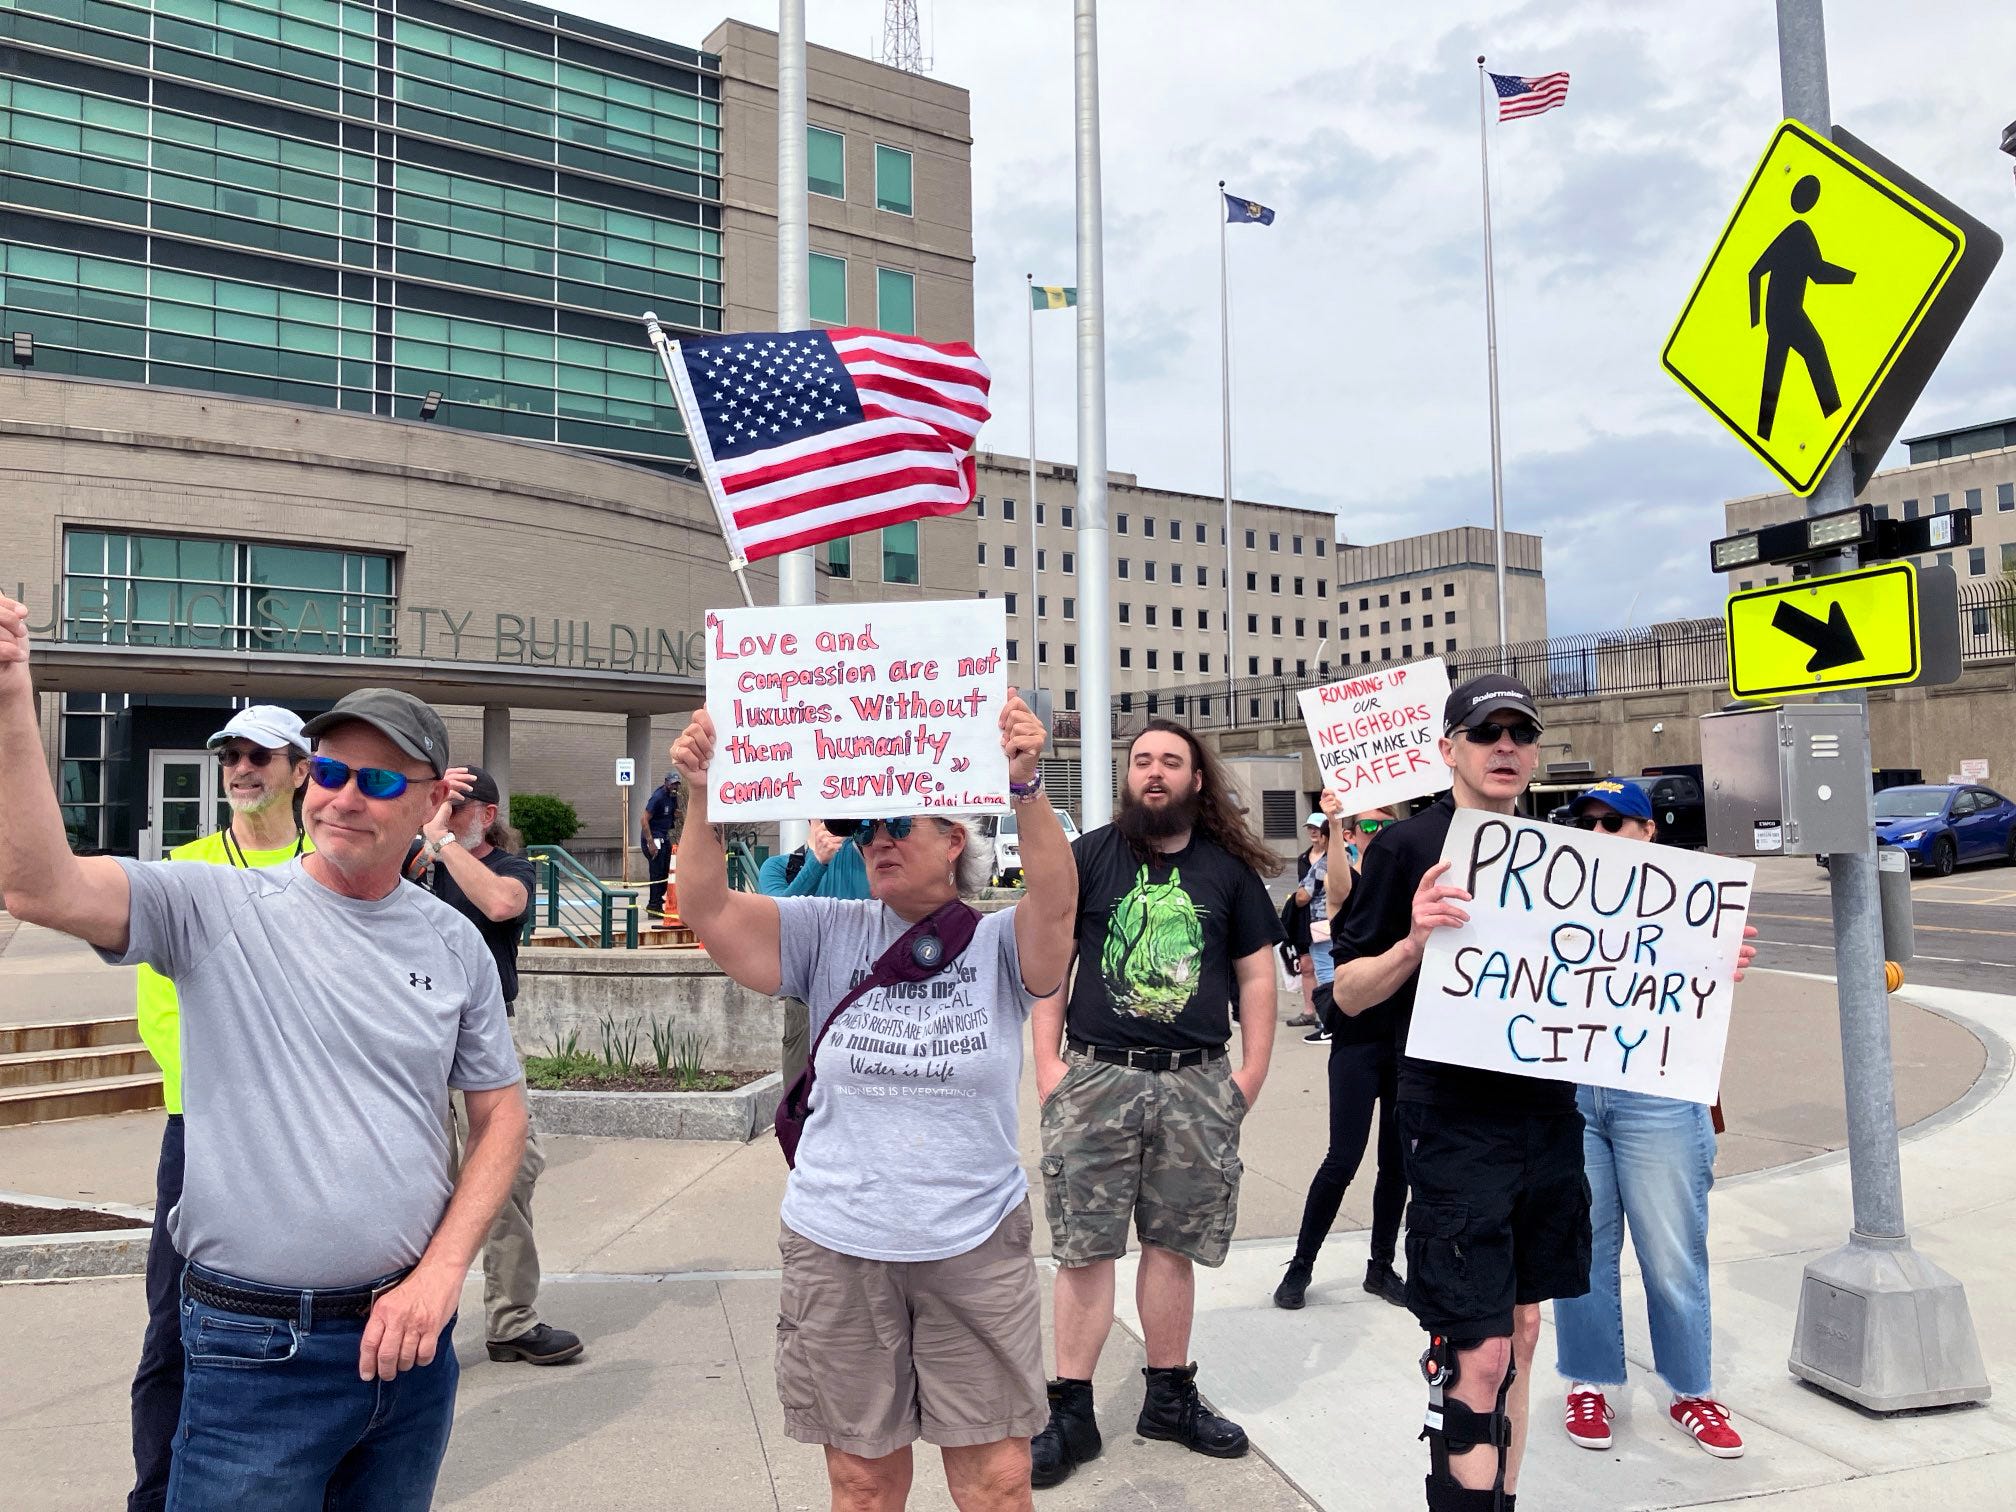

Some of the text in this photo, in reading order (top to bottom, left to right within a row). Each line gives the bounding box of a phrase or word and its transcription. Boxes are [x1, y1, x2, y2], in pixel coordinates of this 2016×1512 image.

[0, 582, 227, 640] UBLIC
[254, 595, 474, 653] SAFETY
[815, 623, 880, 652] and
[738, 647, 1001, 702] compassion are not
[1319, 670, 1408, 706] ROUNDING UP
[733, 687, 988, 729] luxuries. Without
[1353, 697, 1382, 714] OUR
[1318, 704, 1432, 748] NEIGHBORS
[1372, 733, 1407, 757] MAKE
[1412, 727, 1432, 746] US
[725, 724, 951, 765] them humanity
[719, 772, 802, 804] cannot
[1335, 749, 1431, 793] SAFER
[962, 791, 1006, 806] Lama
[1466, 819, 1749, 939] PROUD OF
[1551, 923, 1664, 967] OUR
[1442, 947, 1717, 1019] SANCTUARY
[871, 1013, 904, 1038] RIGHTS
[903, 1023, 924, 1040] ARE
[956, 1006, 989, 1032] RIGHTS
[918, 1005, 931, 1022] IS
[845, 1033, 907, 1056] human
[913, 1042, 927, 1058] is
[932, 1031, 988, 1057] illegal
[1507, 1014, 1671, 1076] CITY!
[850, 1053, 955, 1083] Water is Life
[889, 1086, 899, 1096] IS
[902, 1086, 977, 1098] EVERYTHING
